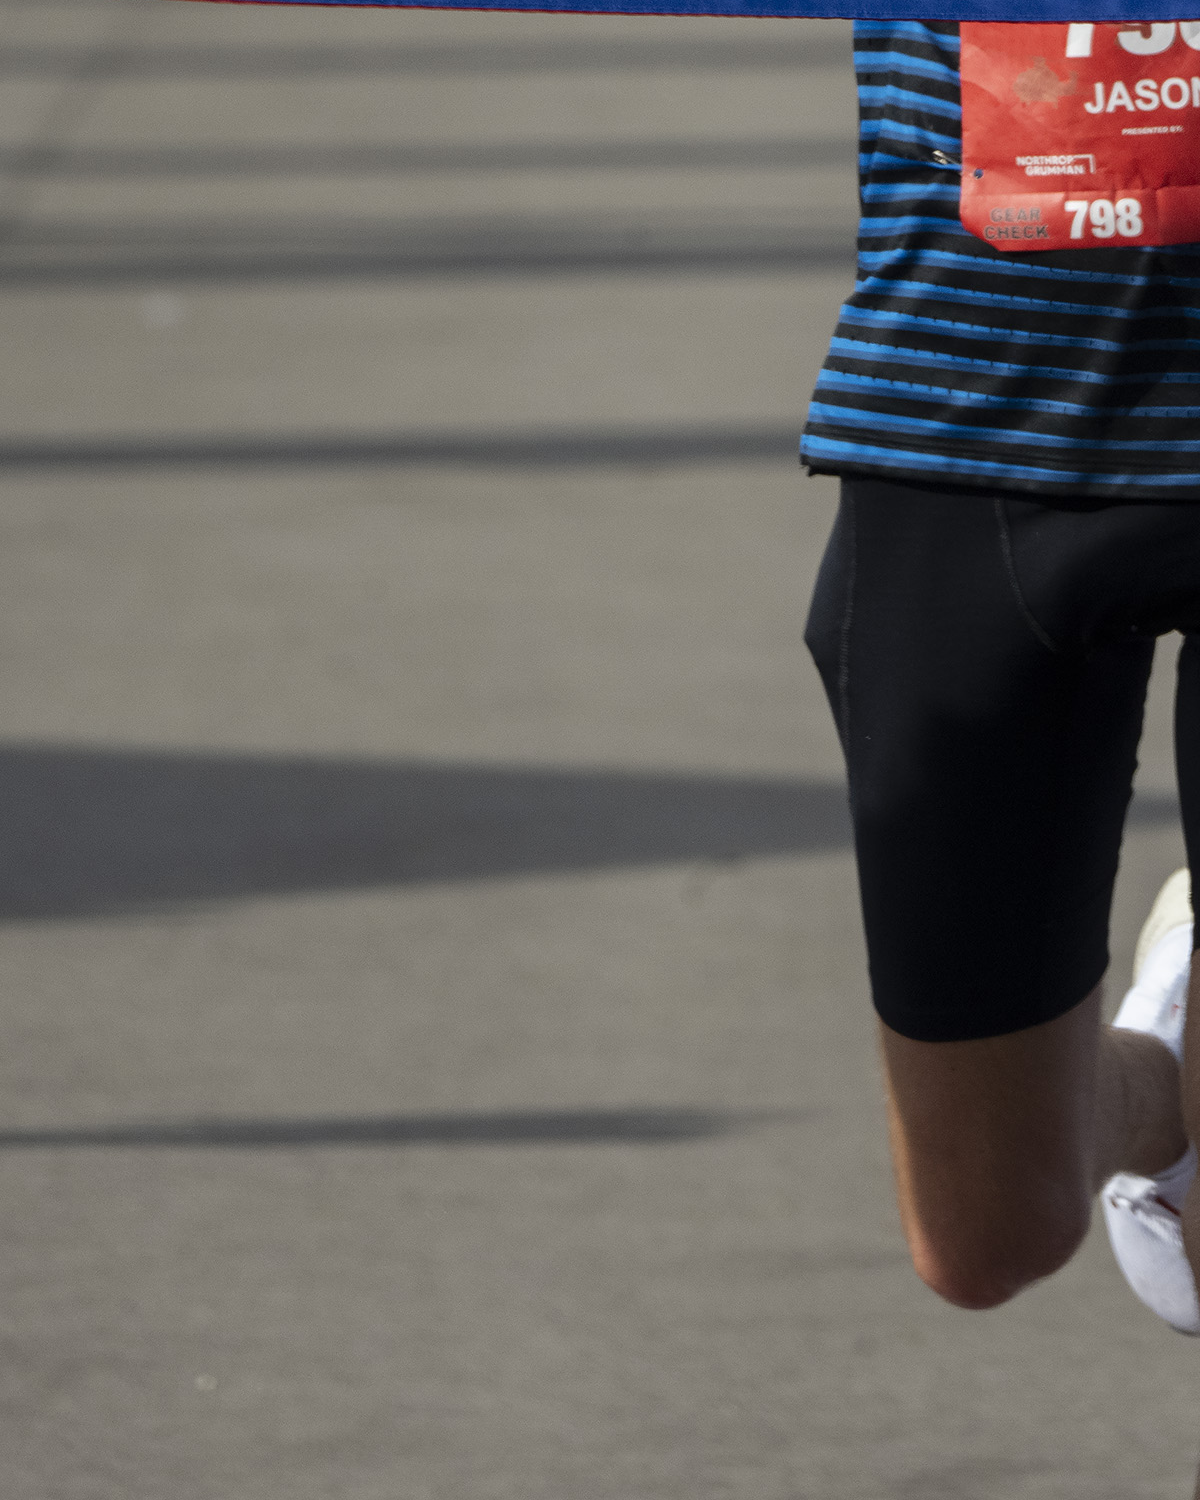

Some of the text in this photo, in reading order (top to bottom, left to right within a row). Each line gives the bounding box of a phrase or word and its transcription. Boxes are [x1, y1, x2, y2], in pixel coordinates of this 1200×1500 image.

[1016, 155, 1073, 168] NORTHROP
[1025, 164, 1084, 176] GRUMMAN
[990, 207, 1041, 223] GEAR
[1064, 197, 1144, 240] 798
[983, 224, 1050, 240] CHECK
